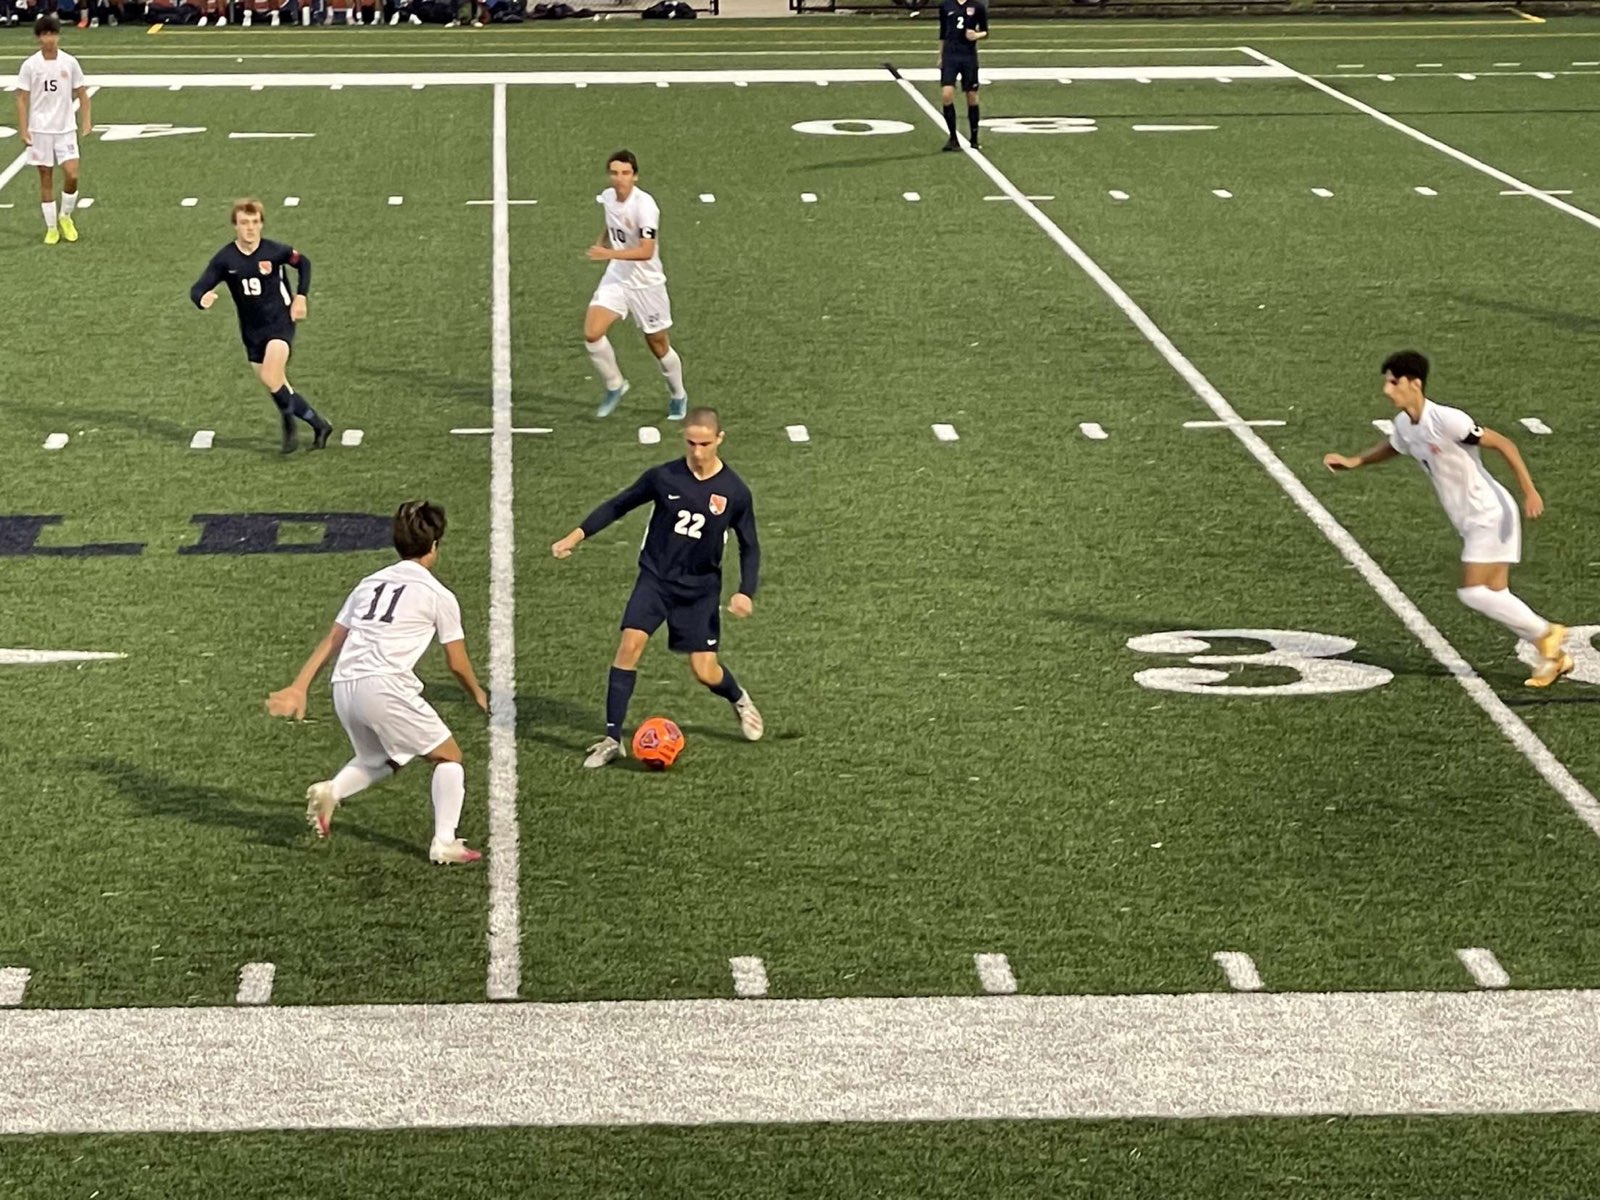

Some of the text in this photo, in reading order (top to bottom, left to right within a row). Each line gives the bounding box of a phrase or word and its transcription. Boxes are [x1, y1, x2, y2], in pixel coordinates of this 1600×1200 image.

[956, 16, 964, 29] 2
[44, 79, 57, 92] 15
[610, 227, 626, 243] 10
[241, 277, 261, 296] 19
[674, 509, 705, 539] 22
[361, 582, 407, 624] 11
